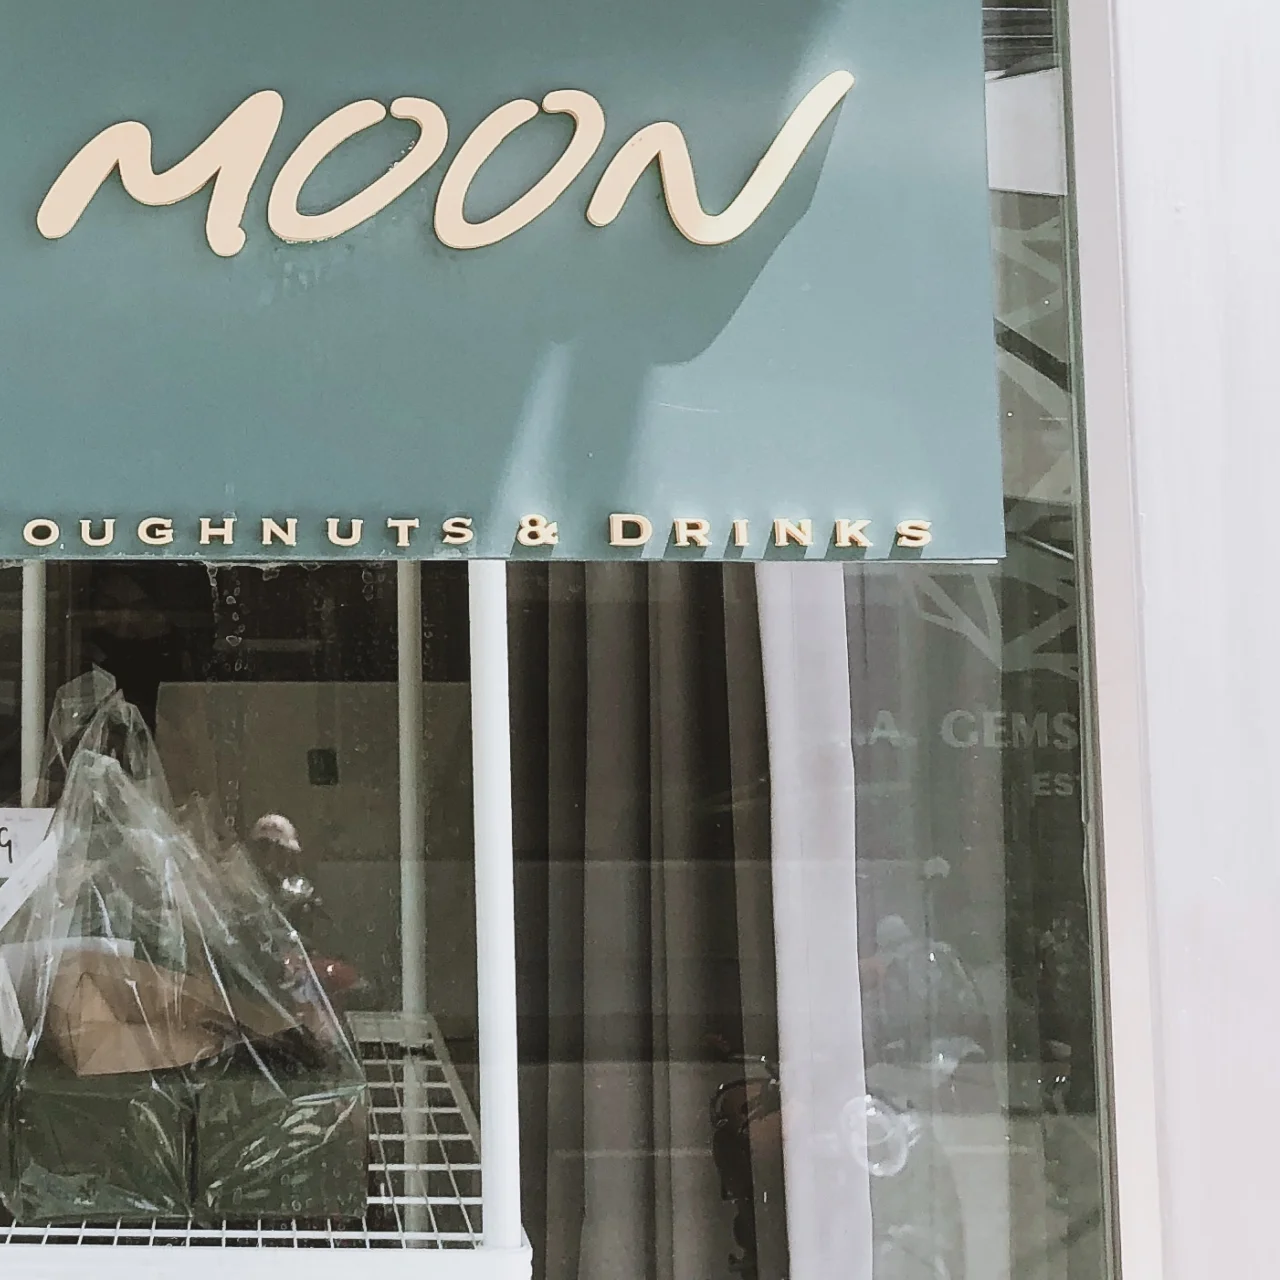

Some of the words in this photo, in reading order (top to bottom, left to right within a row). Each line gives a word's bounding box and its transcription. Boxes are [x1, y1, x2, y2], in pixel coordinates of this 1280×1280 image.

[35, 69, 854, 257] MOON
[518, 513, 559, 549] &
[607, 513, 934, 549] DRINKS
[939, 709, 1079, 751] GEMS
